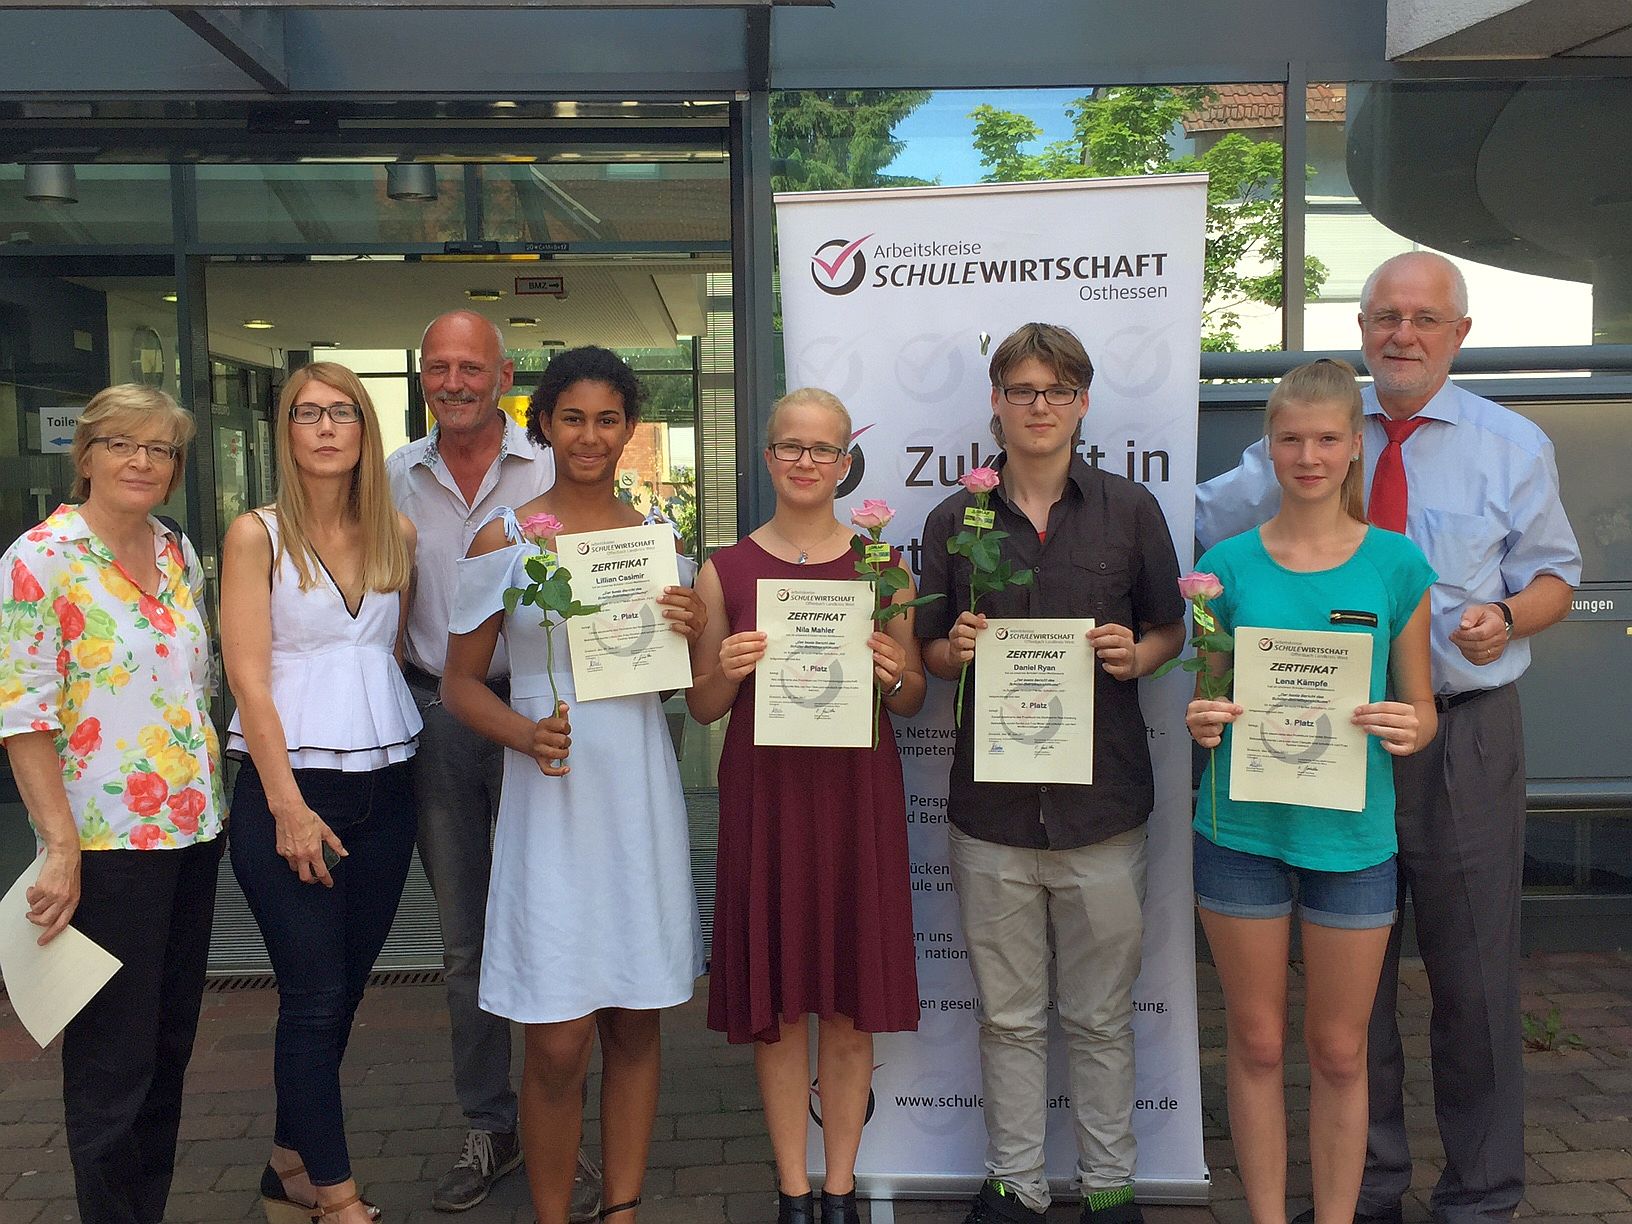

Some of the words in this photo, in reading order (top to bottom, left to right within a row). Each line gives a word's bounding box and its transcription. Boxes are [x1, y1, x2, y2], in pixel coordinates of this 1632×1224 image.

[874, 240, 982, 258] Arbeitskreise
[872, 253, 1168, 288] SCHULEWIRTSCHAFT
[528, 282, 548, 290] BMZ
[1080, 284, 1168, 300] Osthessen
[46, 416, 78, 426] Toile
[1127, 440, 1170, 482] in
[591, 540, 656, 553] SCHULEWIRTSCHAFT
[591, 558, 648, 572] ZERTIFIKAT
[618, 573, 644, 582] Casimir
[787, 612, 846, 622] ZERTIFIKAT
[1006, 650, 1066, 659] ZERTIFIKAT
[1274, 644, 1349, 656] SCHULEWIRTSCHAFT
[1270, 663, 1338, 674] ZERTIFIKAT
[1297, 679, 1328, 688] Kämpfe
[906, 726, 957, 738] Netzwe
[910, 795, 948, 808] Persp
[920, 812, 949, 823] Beru
[910, 862, 950, 874] ücken
[937, 882, 953, 891] un
[929, 932, 952, 942] uns
[925, 948, 968, 959] nation
